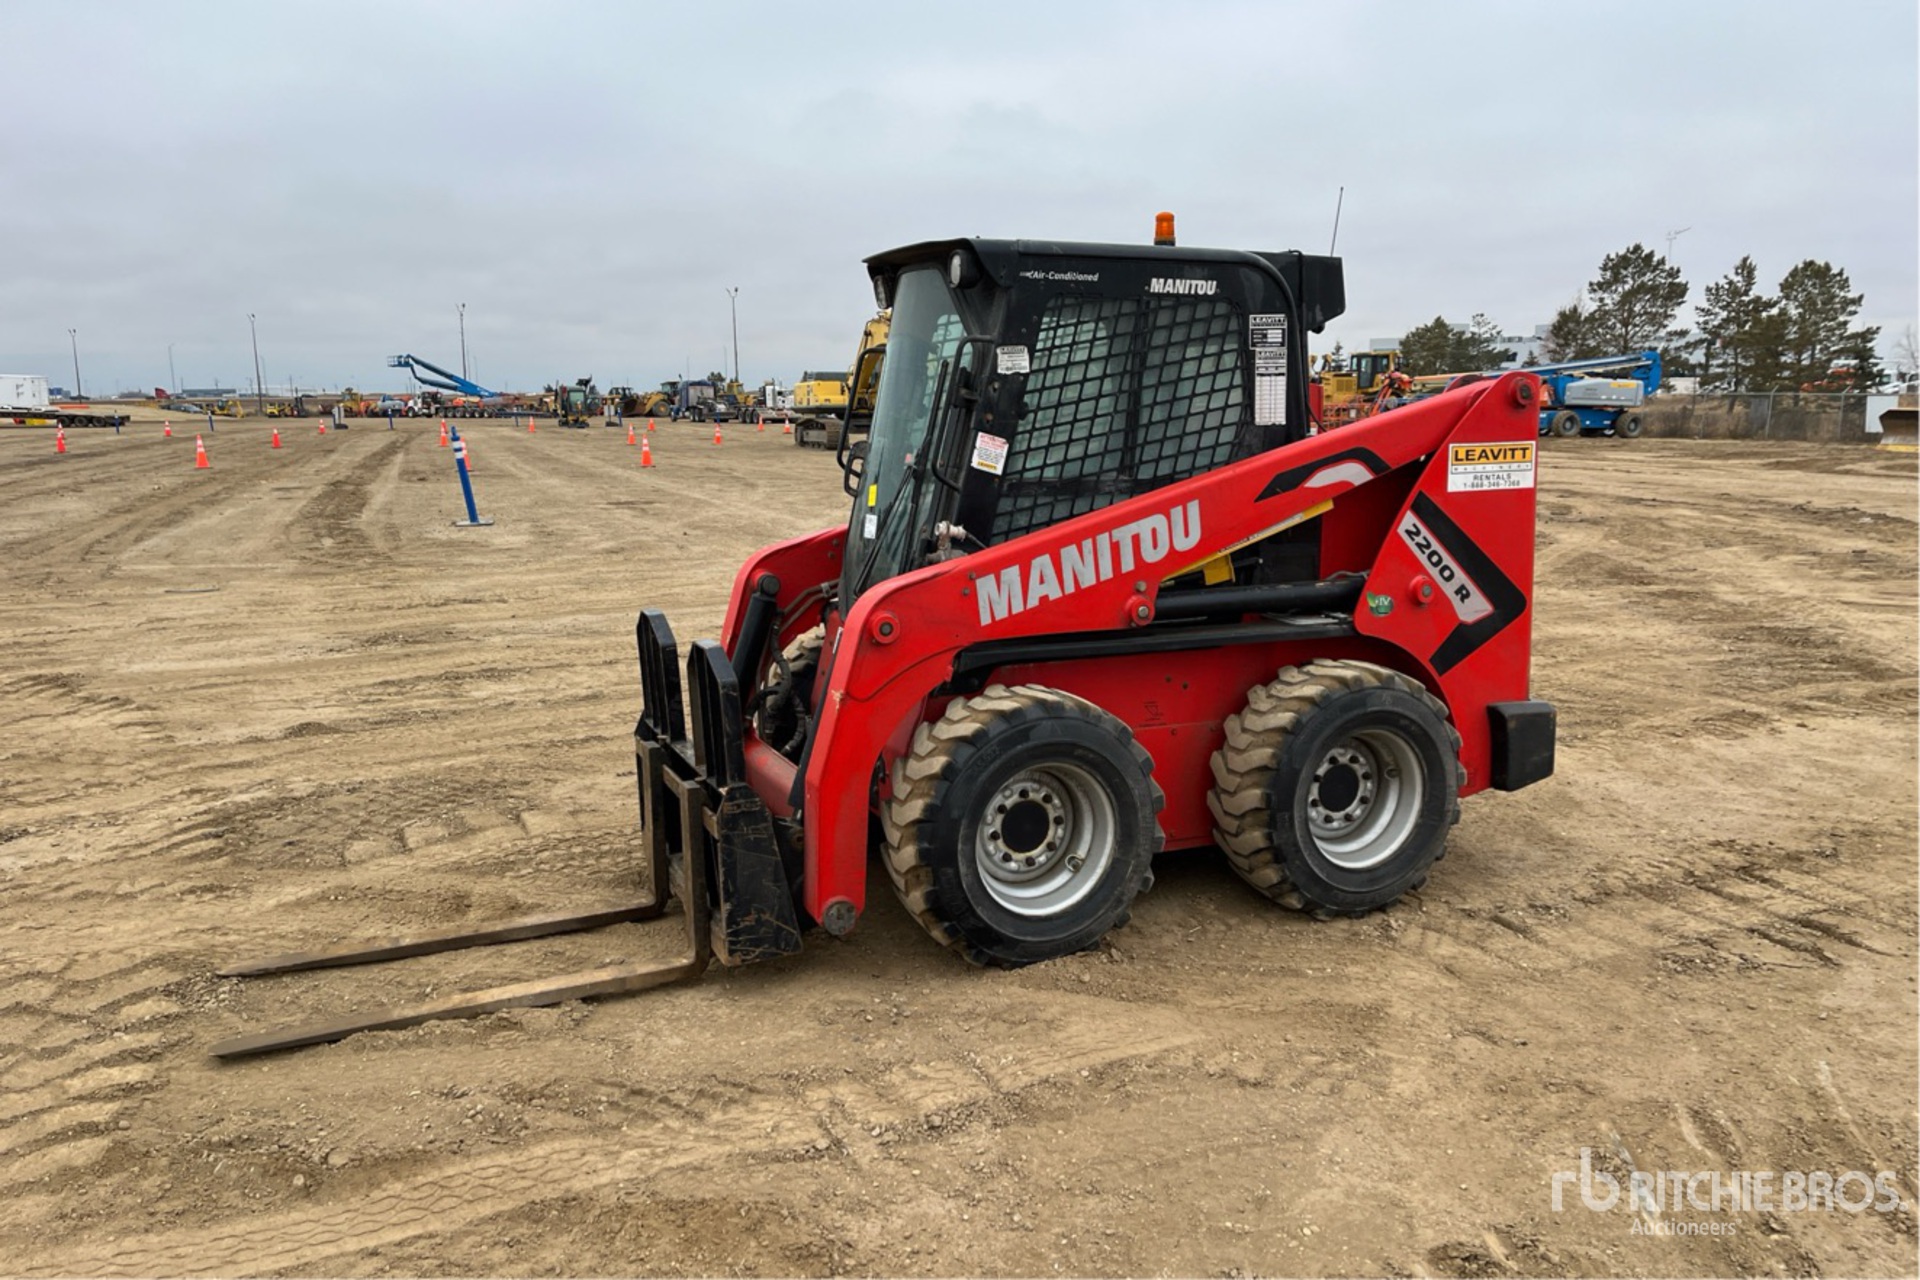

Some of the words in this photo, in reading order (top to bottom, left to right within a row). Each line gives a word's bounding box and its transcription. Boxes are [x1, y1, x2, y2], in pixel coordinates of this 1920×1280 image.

[1032, 270, 1099, 281] Air-Conditioned
[1150, 278, 1217, 295] MANITOU
[1454, 446, 1530, 462] LEAVITT
[1472, 472, 1512, 481] RENTALS
[975, 499, 1202, 627] MANITOU
[1404, 523, 1455, 583] 2200
[1454, 583, 1471, 605] R
